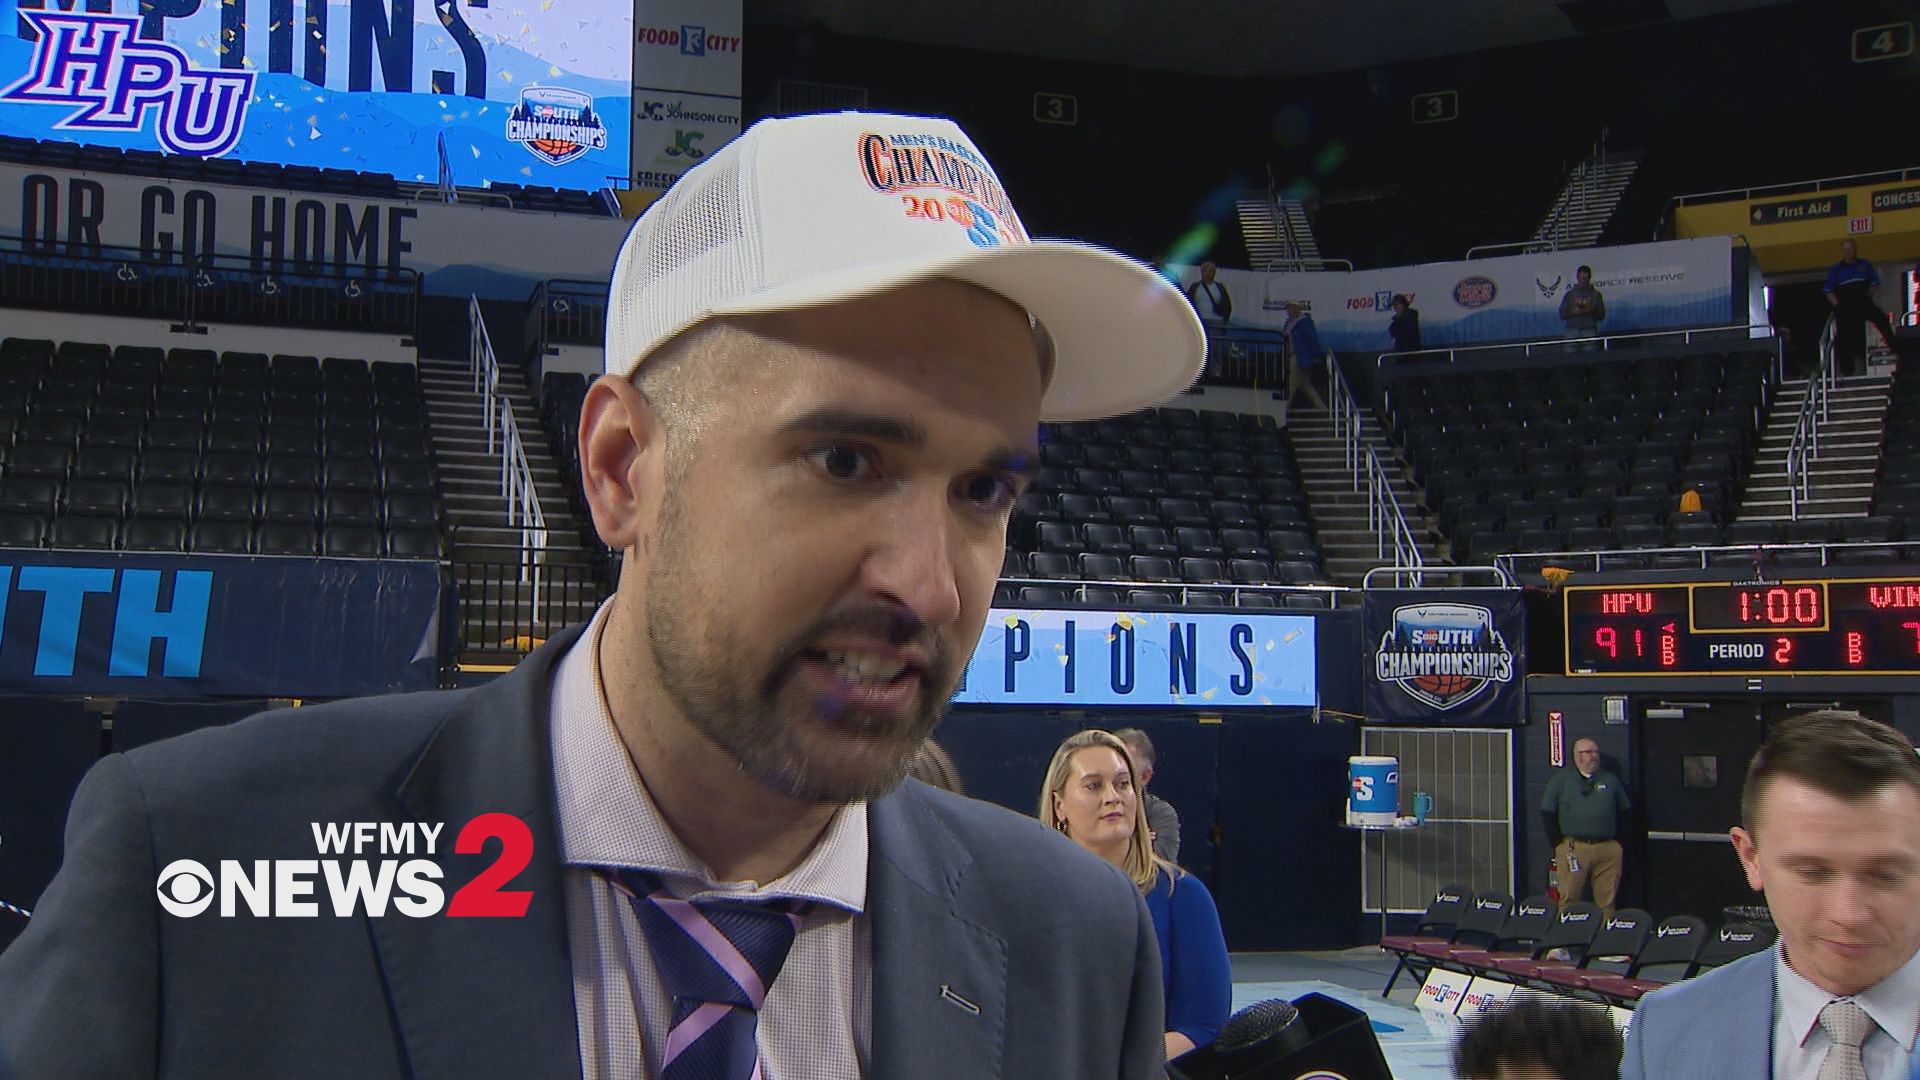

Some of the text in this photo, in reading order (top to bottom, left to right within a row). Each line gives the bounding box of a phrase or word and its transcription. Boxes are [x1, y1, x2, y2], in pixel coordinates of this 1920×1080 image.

[638, 28, 740, 53] FOOD CITY
[1872, 31, 1893, 53] 4
[28, 12, 252, 153] HPU
[666, 110, 740, 125] JOHNSON CITY
[1047, 98, 1064, 119] 3
[1426, 97, 1444, 118] 3
[508, 119, 605, 148] CHAMPIONSHIPS
[1777, 202, 1832, 218] First Aid
[22, 174, 418, 282] OR GO HOME
[1850, 218, 1868, 231] EXIT
[1347, 297, 1375, 310] FOOD
[1601, 592, 1652, 614] HPU
[1740, 587, 1818, 623] 1:00
[0, 565, 213, 678] TH
[1411, 629, 1474, 645] SOUTH
[1595, 627, 1643, 658] 91
[960, 619, 1254, 695] PIONS
[1709, 638, 1791, 663] PERIOD 2
[1379, 651, 1510, 679] CHAMPIONSHIPS
[1423, 984, 1440, 997] FOOD
